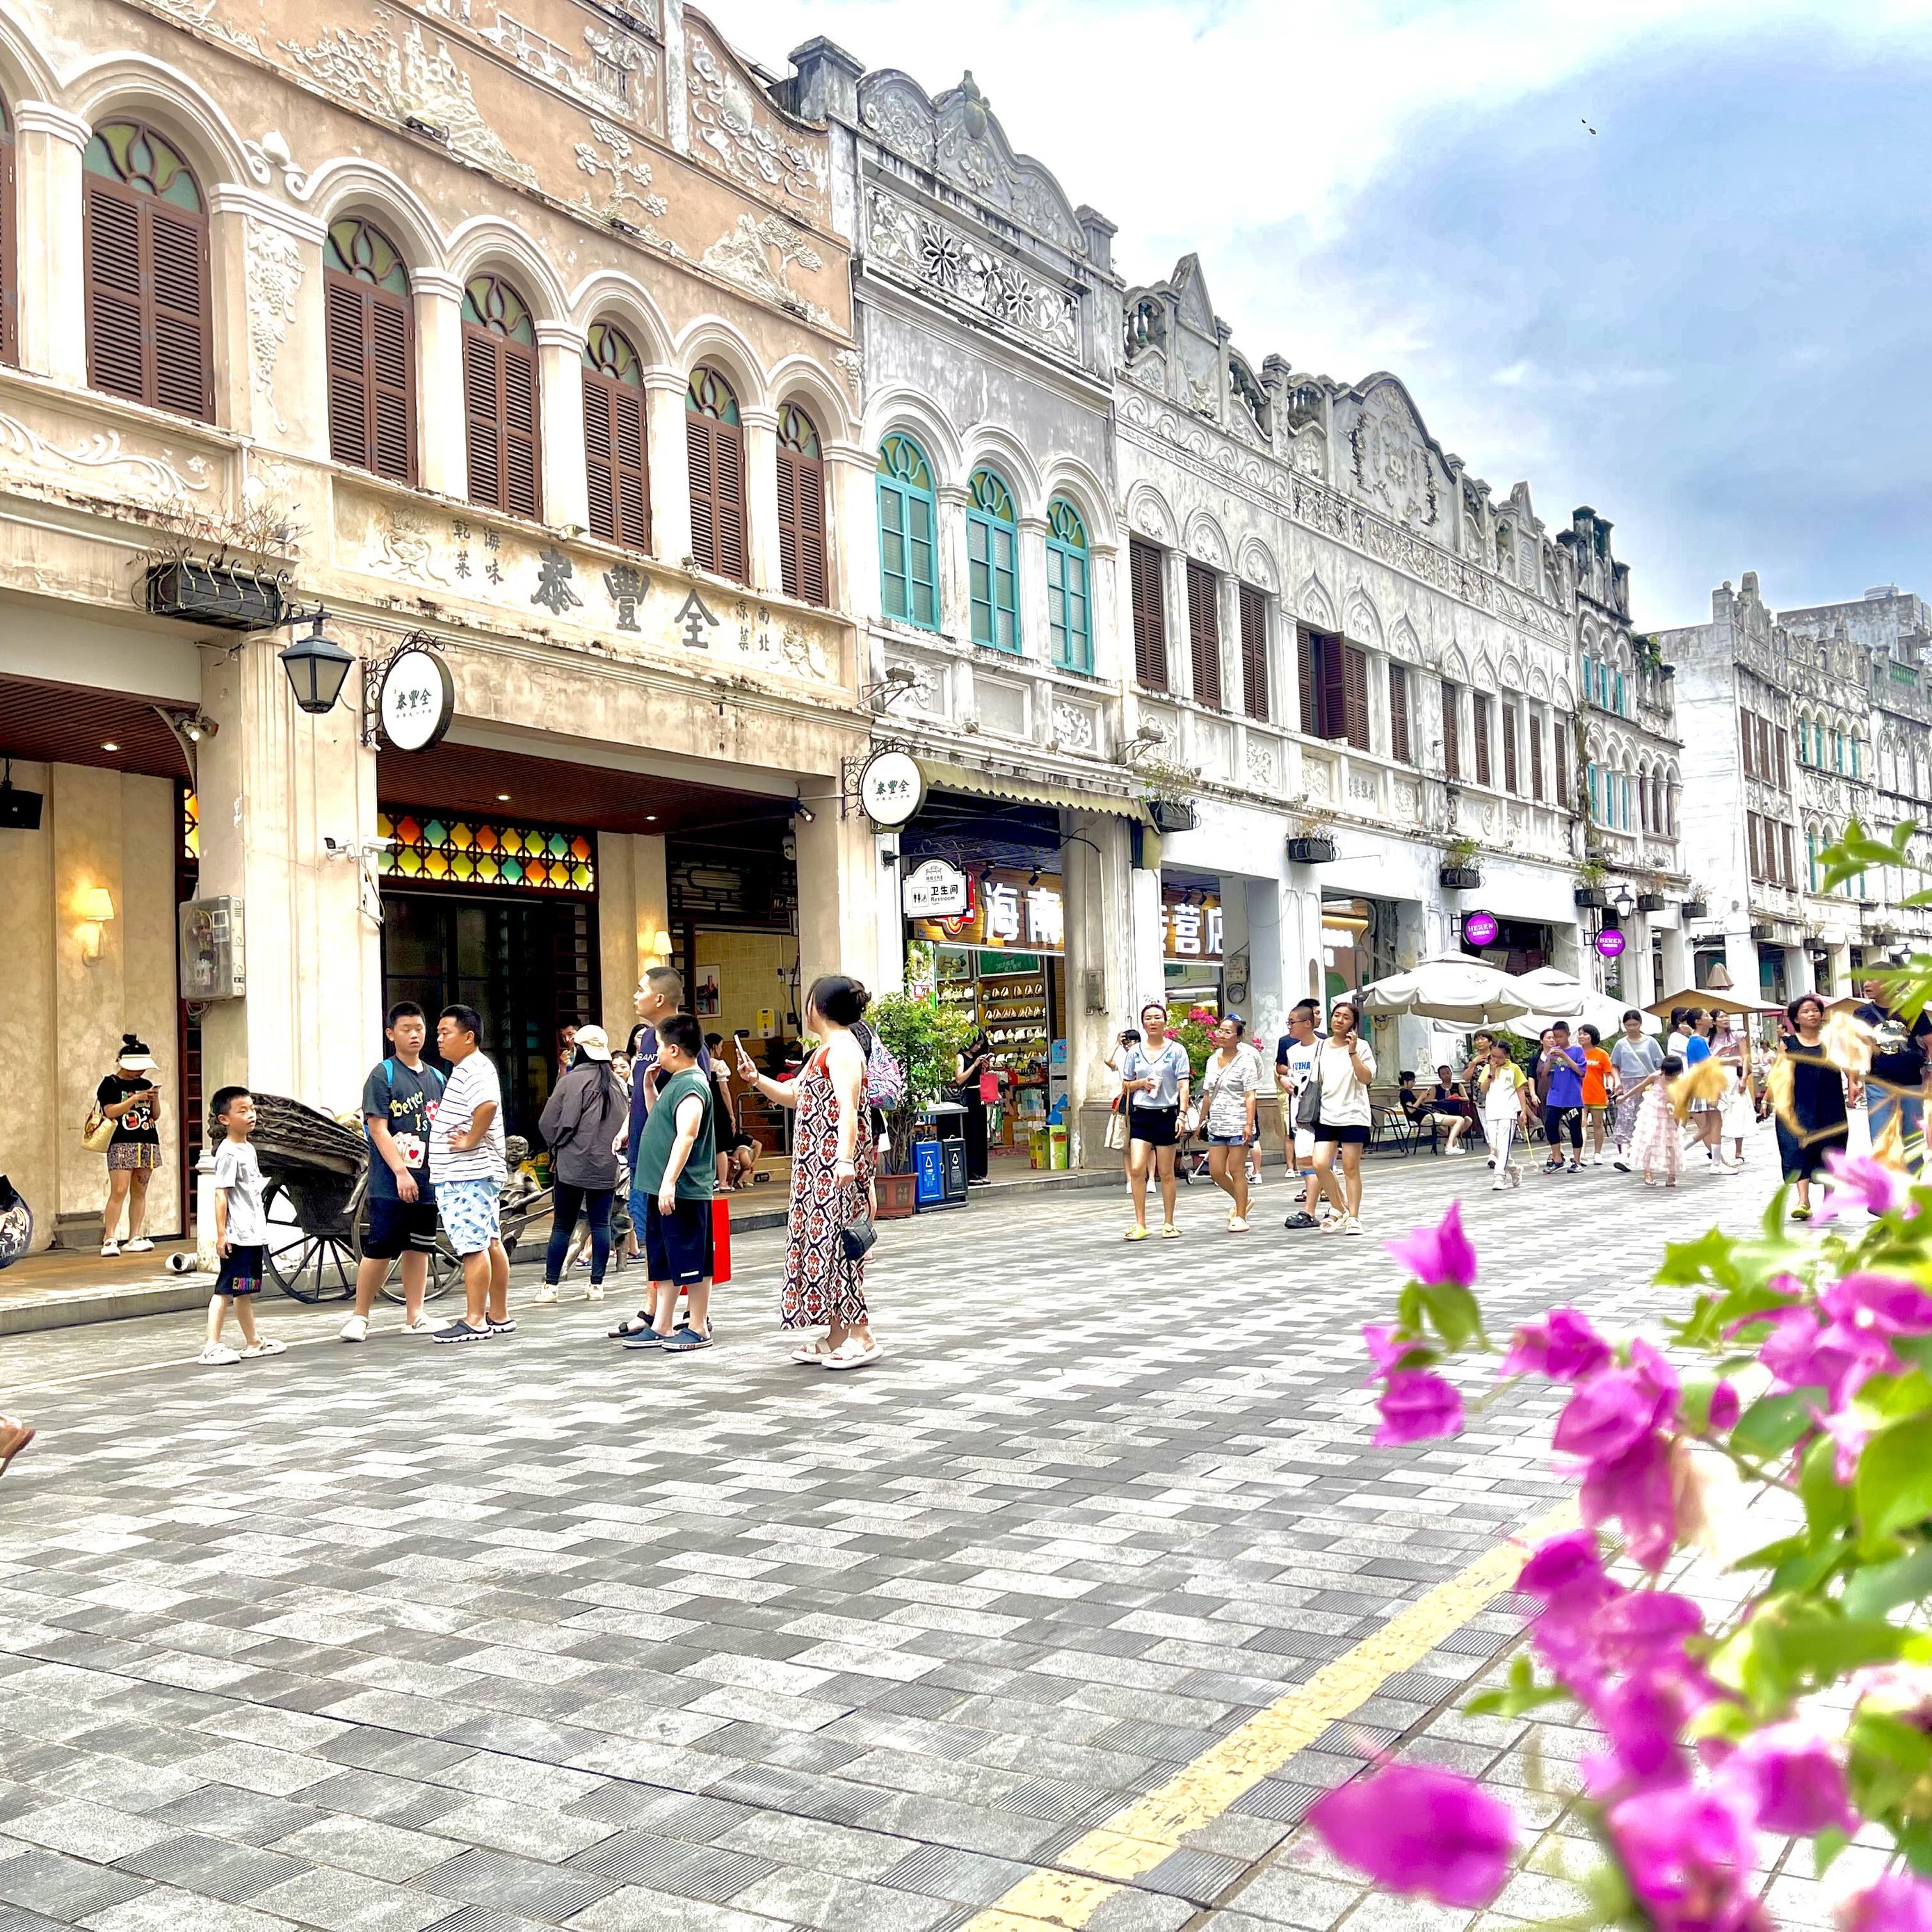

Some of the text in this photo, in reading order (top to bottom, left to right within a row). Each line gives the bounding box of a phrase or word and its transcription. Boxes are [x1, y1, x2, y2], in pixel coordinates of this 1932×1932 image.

[483, 526, 504, 586] 海味
[931, 884, 958, 896] 卫生间
[984, 882, 1061, 944] 海南
[1467, 923, 1493, 932] HEREN
[389, 1091, 423, 1117] Better
